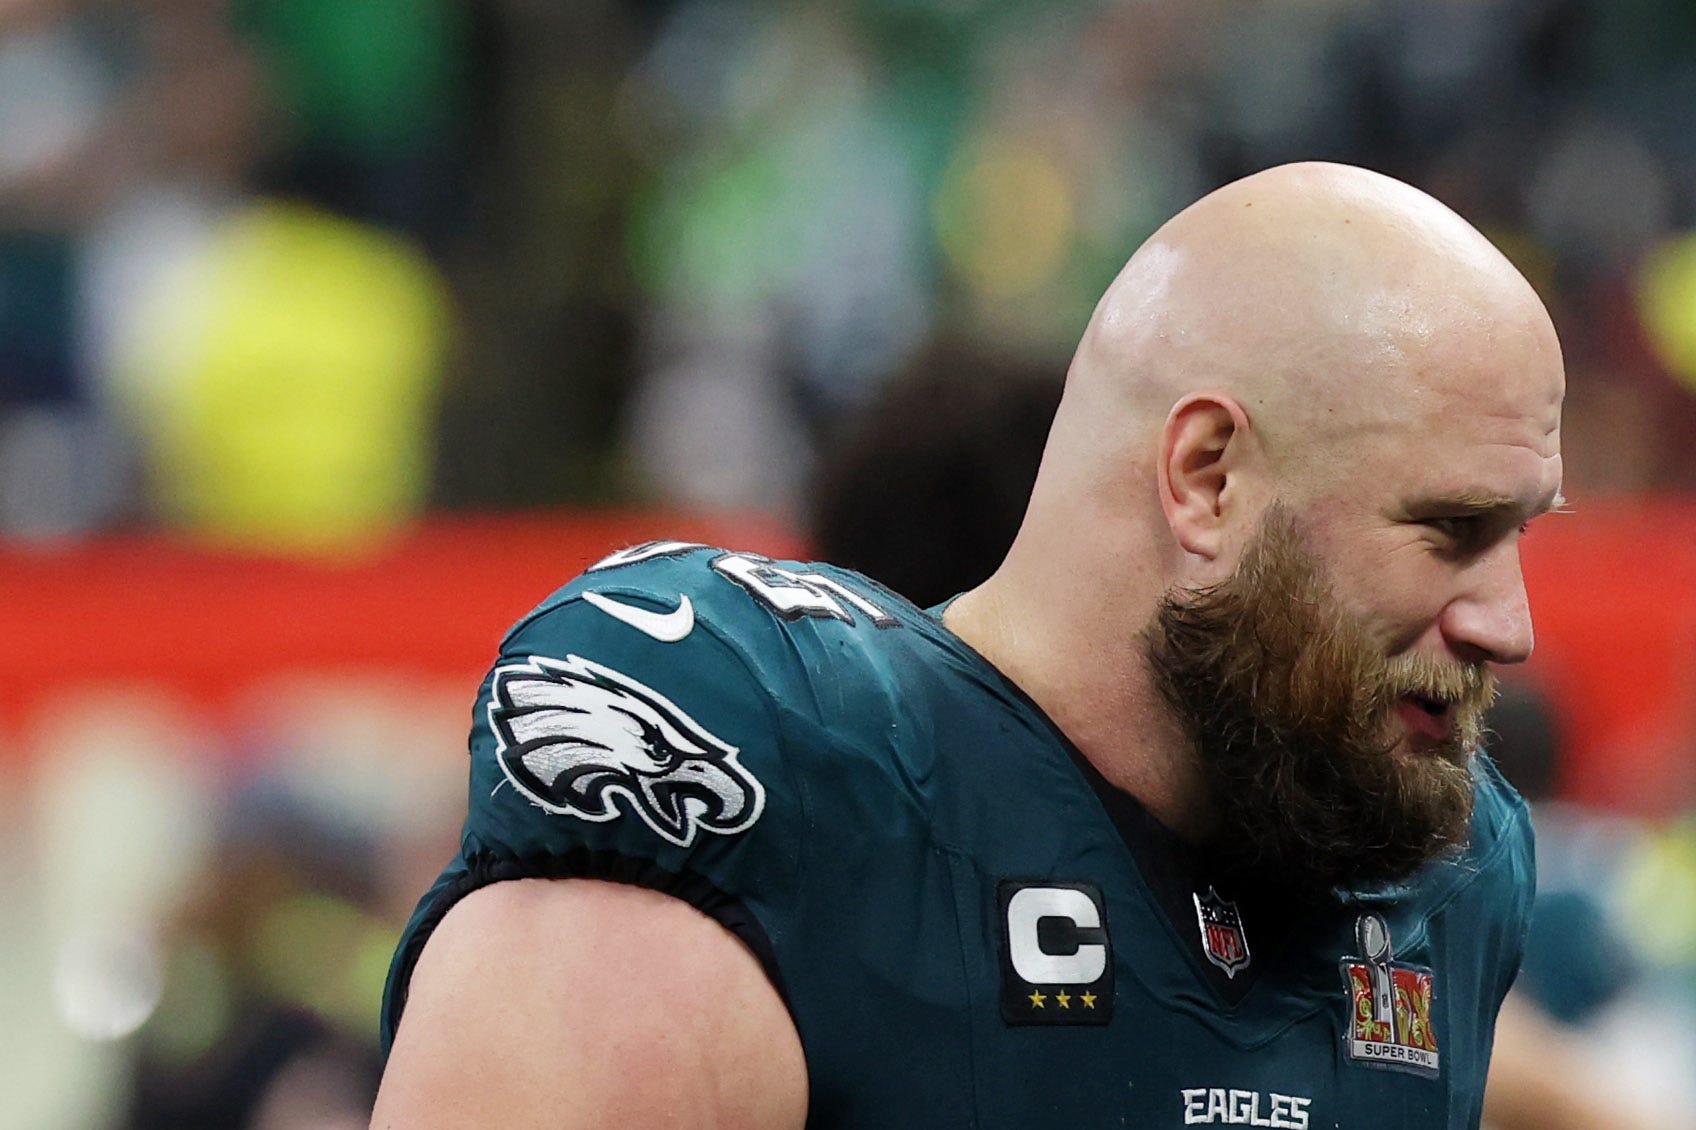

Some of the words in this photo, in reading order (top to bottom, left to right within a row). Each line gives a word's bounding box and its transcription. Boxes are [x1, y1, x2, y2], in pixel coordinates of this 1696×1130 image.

[1007, 887, 1106, 985] C
[1364, 1043, 1405, 1060] SUPER
[1408, 1049, 1432, 1065] BOWL
[1181, 1088, 1312, 1130] EAGLES
